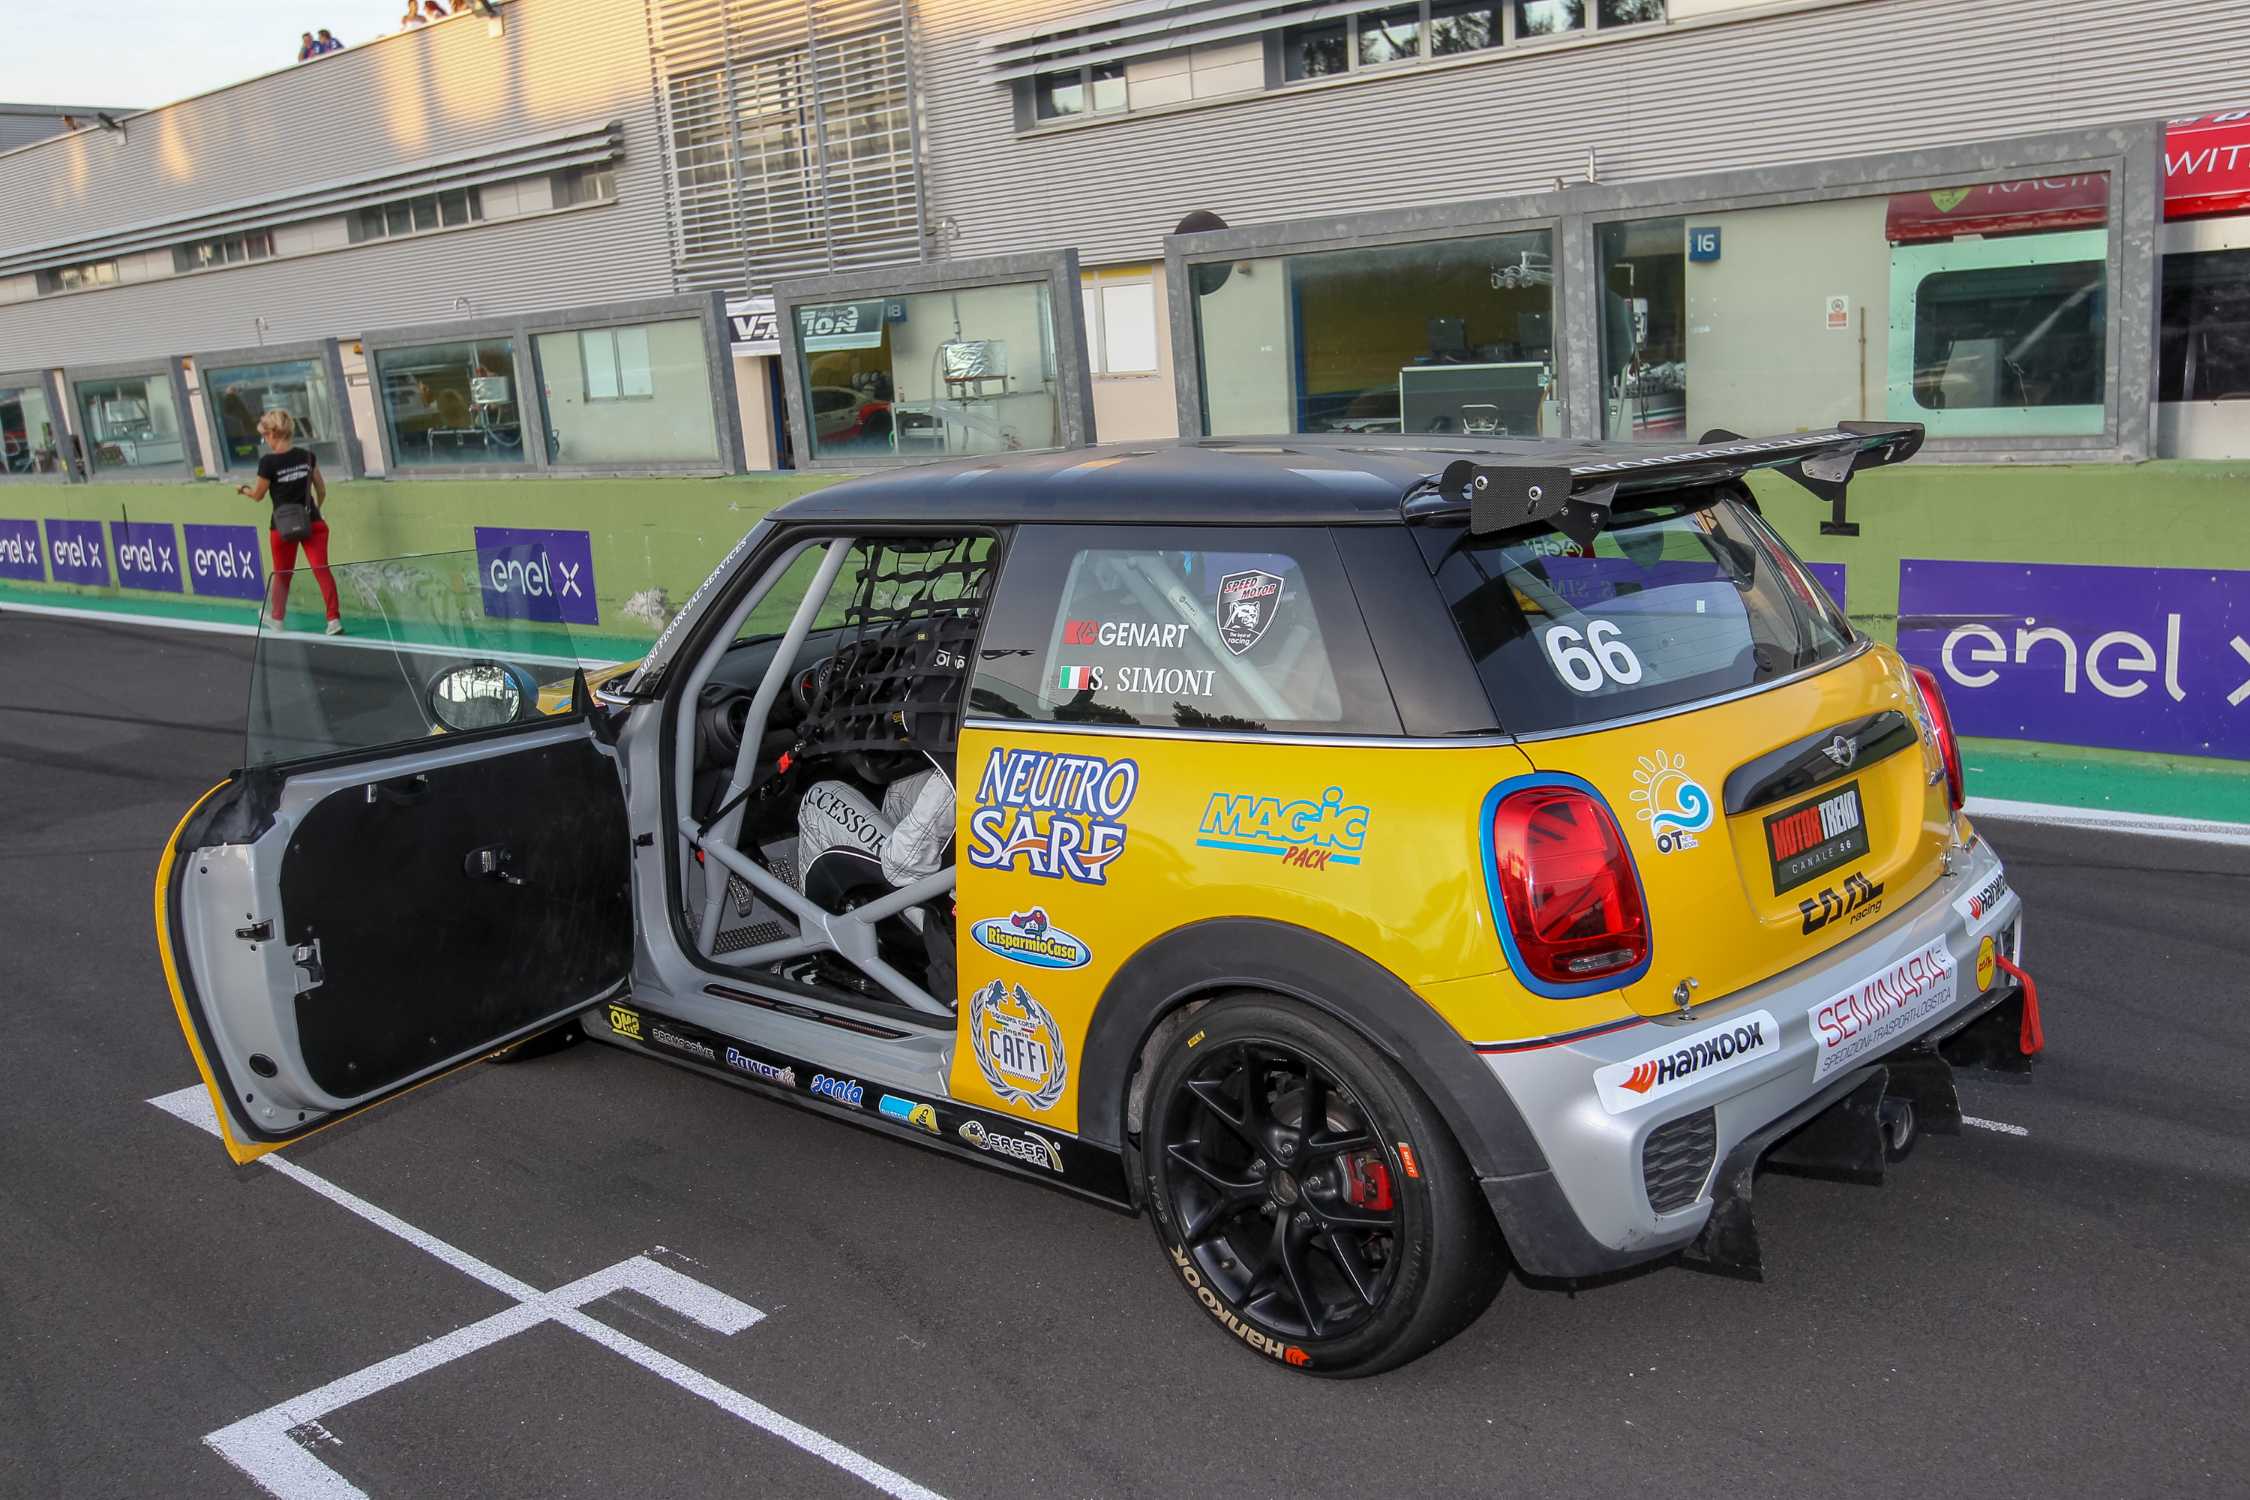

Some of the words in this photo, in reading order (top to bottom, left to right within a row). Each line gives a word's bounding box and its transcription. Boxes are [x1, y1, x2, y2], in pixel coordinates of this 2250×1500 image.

[1697, 234, 1715, 252] 16
[54, 534, 87, 567] enel
[120, 538, 157, 573] enel
[194, 542, 238, 579] enel
[490, 551, 553, 598] enel
[1224, 577, 1258, 594] SPEED
[639, 646, 659, 676] MINI
[657, 590, 703, 649] FINANCIAL
[702, 536, 748, 591] SERVICES
[1241, 584, 1277, 600] MOTOR
[1098, 622, 1189, 649] GENART
[1545, 619, 1642, 692] 66
[1941, 613, 2187, 702] enel
[1090, 666, 1109, 691] S.
[1117, 666, 1217, 697] SIMONI
[976, 748, 1138, 818] NEUTRO
[1657, 830, 1683, 853] OT
[1282, 846, 1332, 871] PACK
[1792, 847, 1834, 874] CANALE
[1850, 899, 1882, 924] racing
[987, 925, 1076, 961] RisparmioCasa
[1817, 949, 1946, 1048] SEMINARA
[611, 1010, 640, 1034] OMP
[989, 1030, 1048, 1073] CAFFI
[988, 1132, 1048, 1160] SASSA
